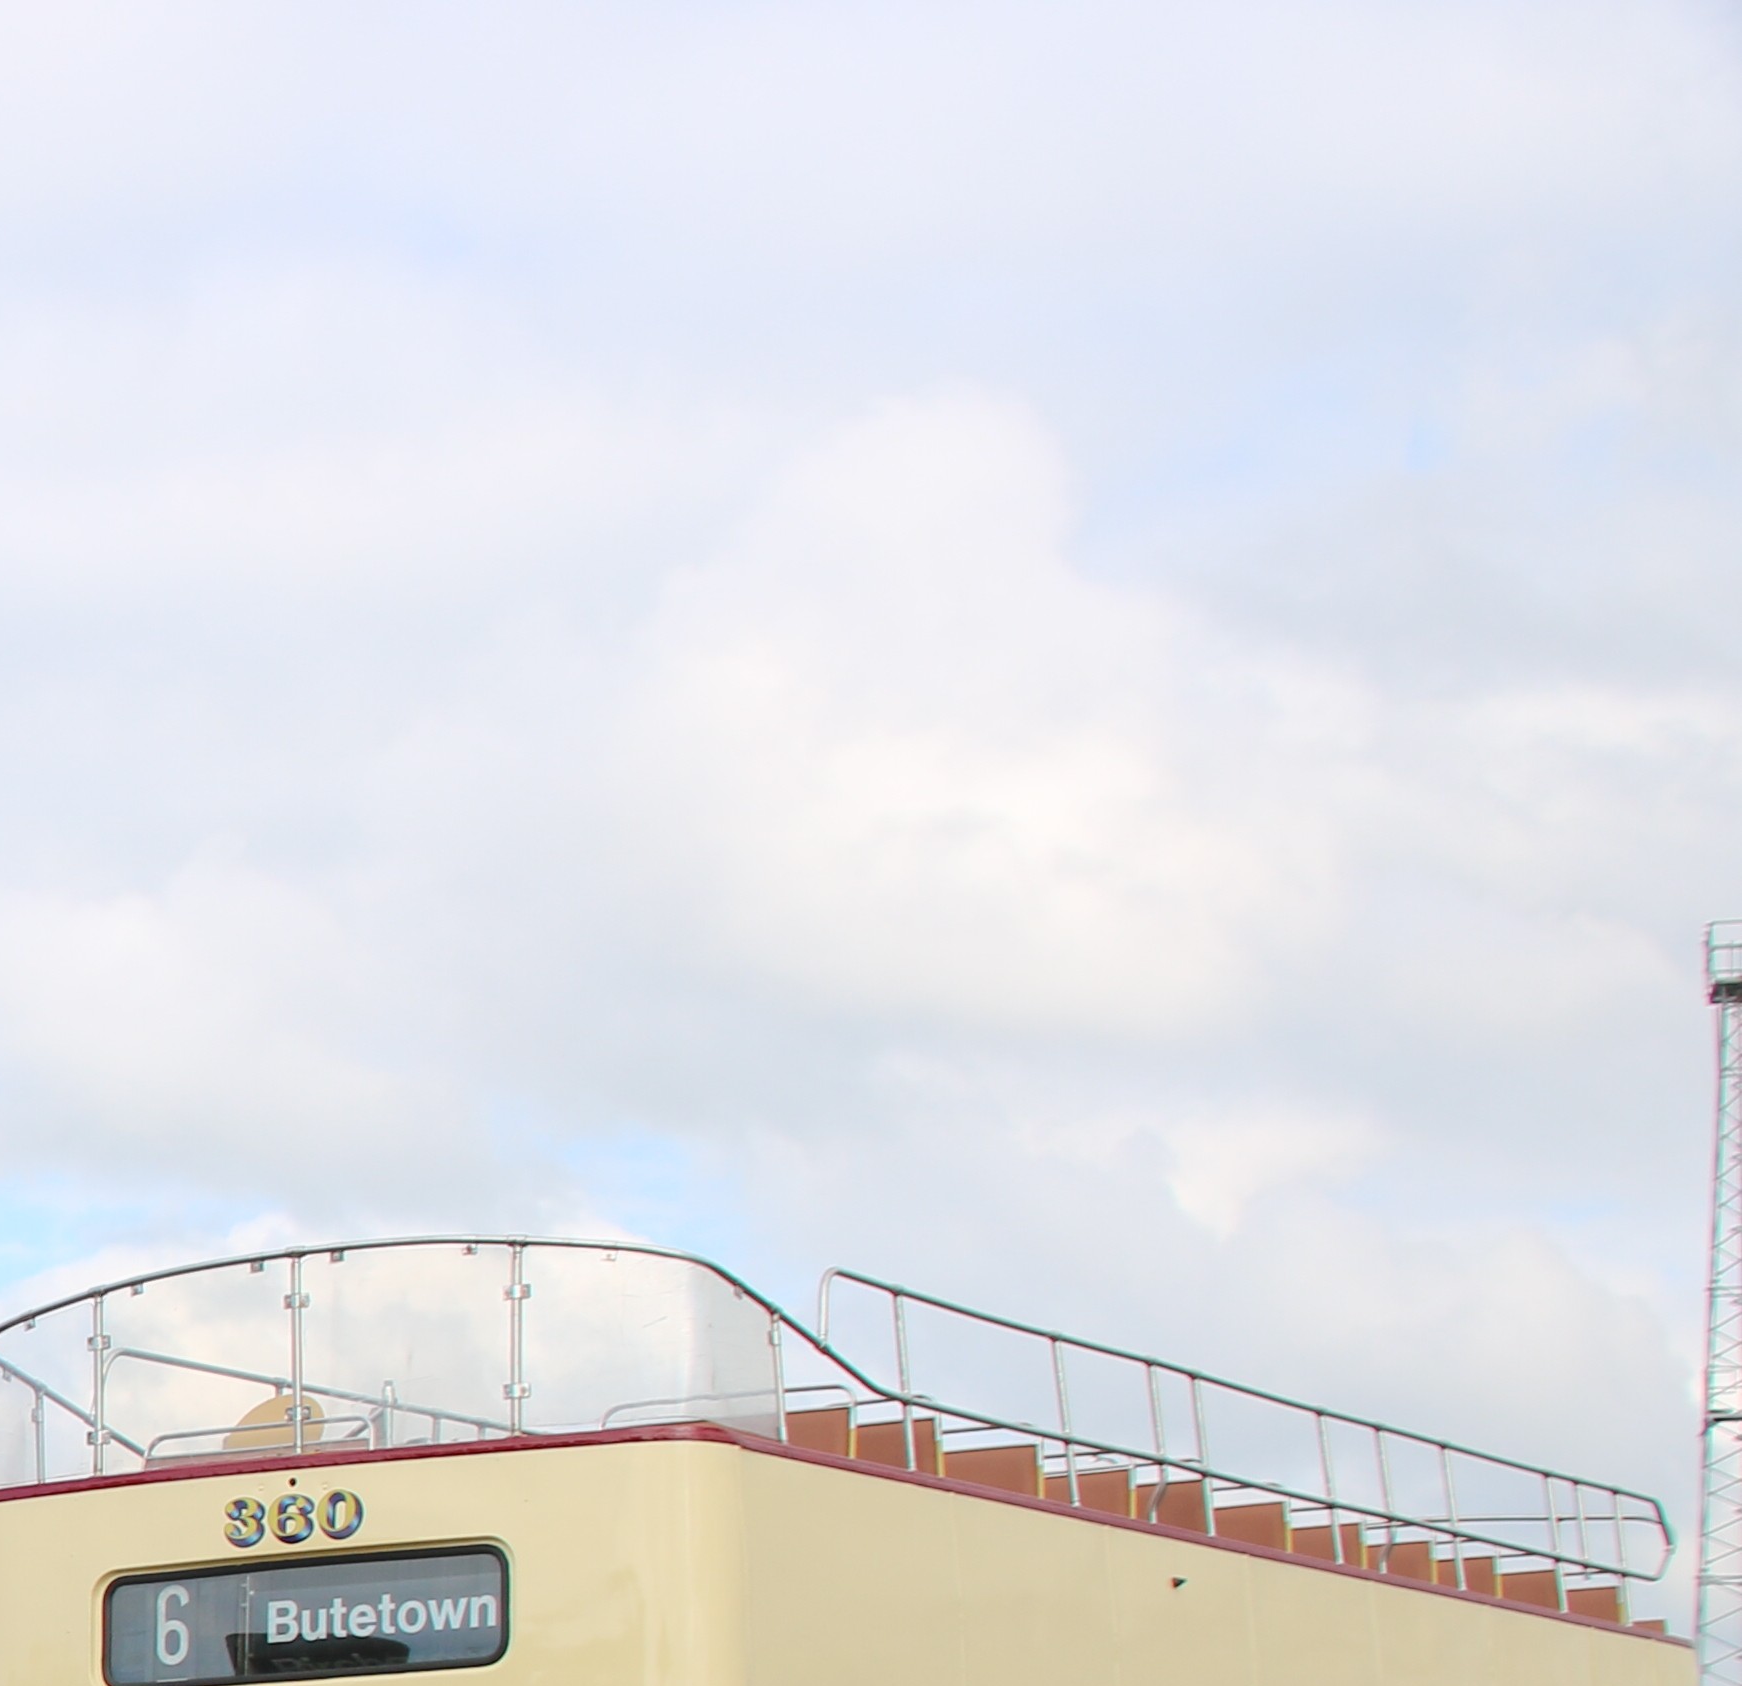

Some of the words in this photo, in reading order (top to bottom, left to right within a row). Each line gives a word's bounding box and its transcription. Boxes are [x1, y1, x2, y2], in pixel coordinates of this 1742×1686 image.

[223, 1488, 365, 1548] 360
[156, 1584, 190, 1666] 6
[267, 1593, 497, 1645] Butetown
